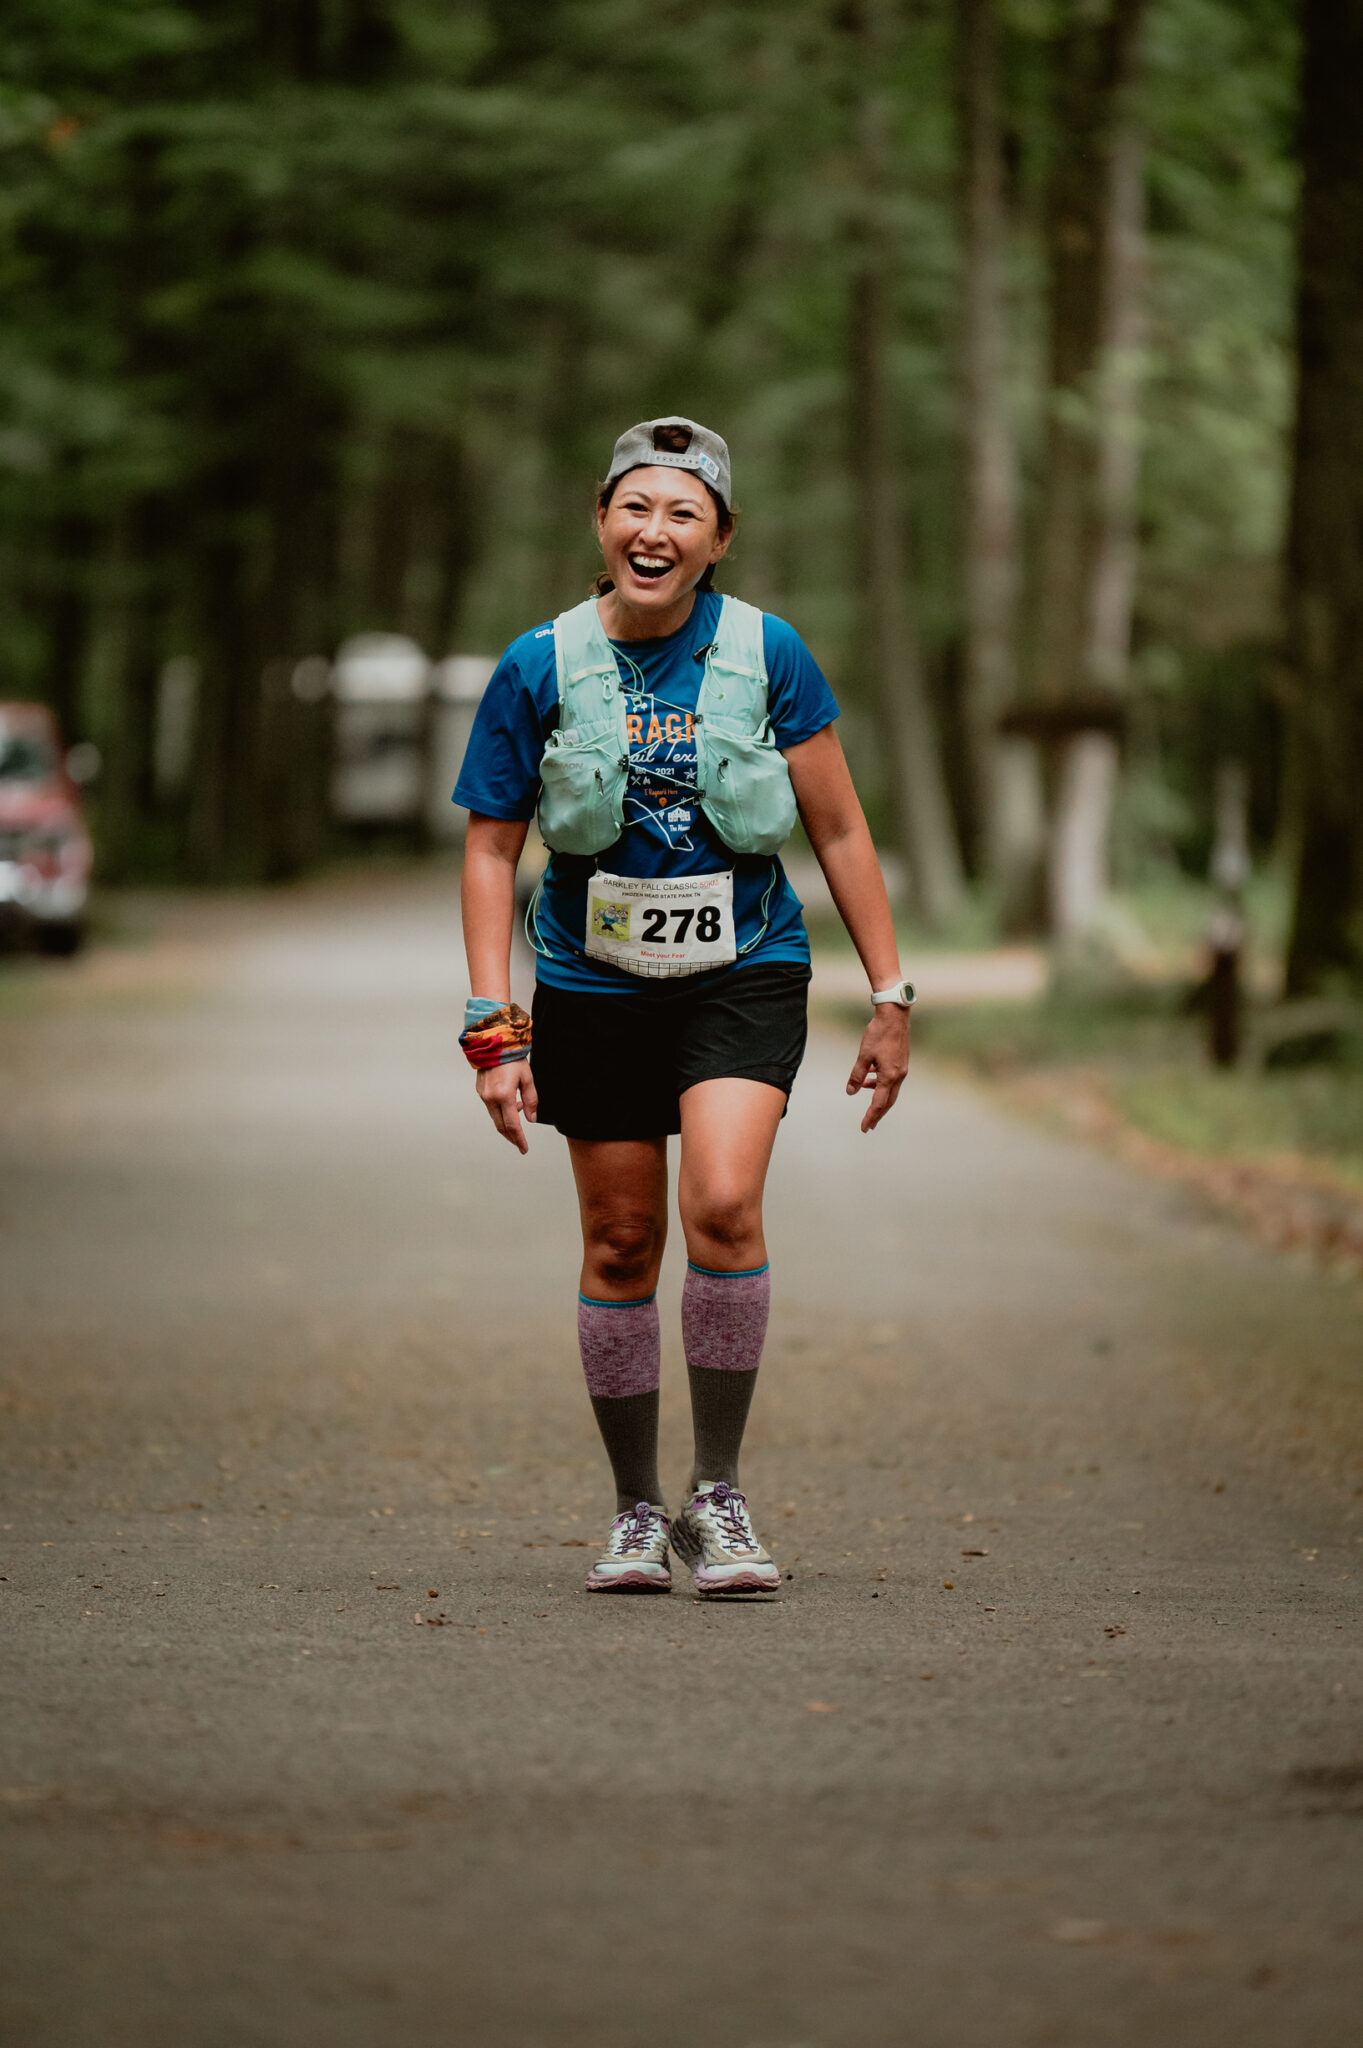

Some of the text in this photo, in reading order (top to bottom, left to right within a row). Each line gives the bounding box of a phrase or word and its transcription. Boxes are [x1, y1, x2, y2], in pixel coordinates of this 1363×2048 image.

[655, 767, 675, 776] 2021
[603, 878, 639, 890] BARKLEY
[641, 882, 661, 891] FALL
[663, 881, 698, 890] CLASSIC
[641, 905, 721, 944] 278
